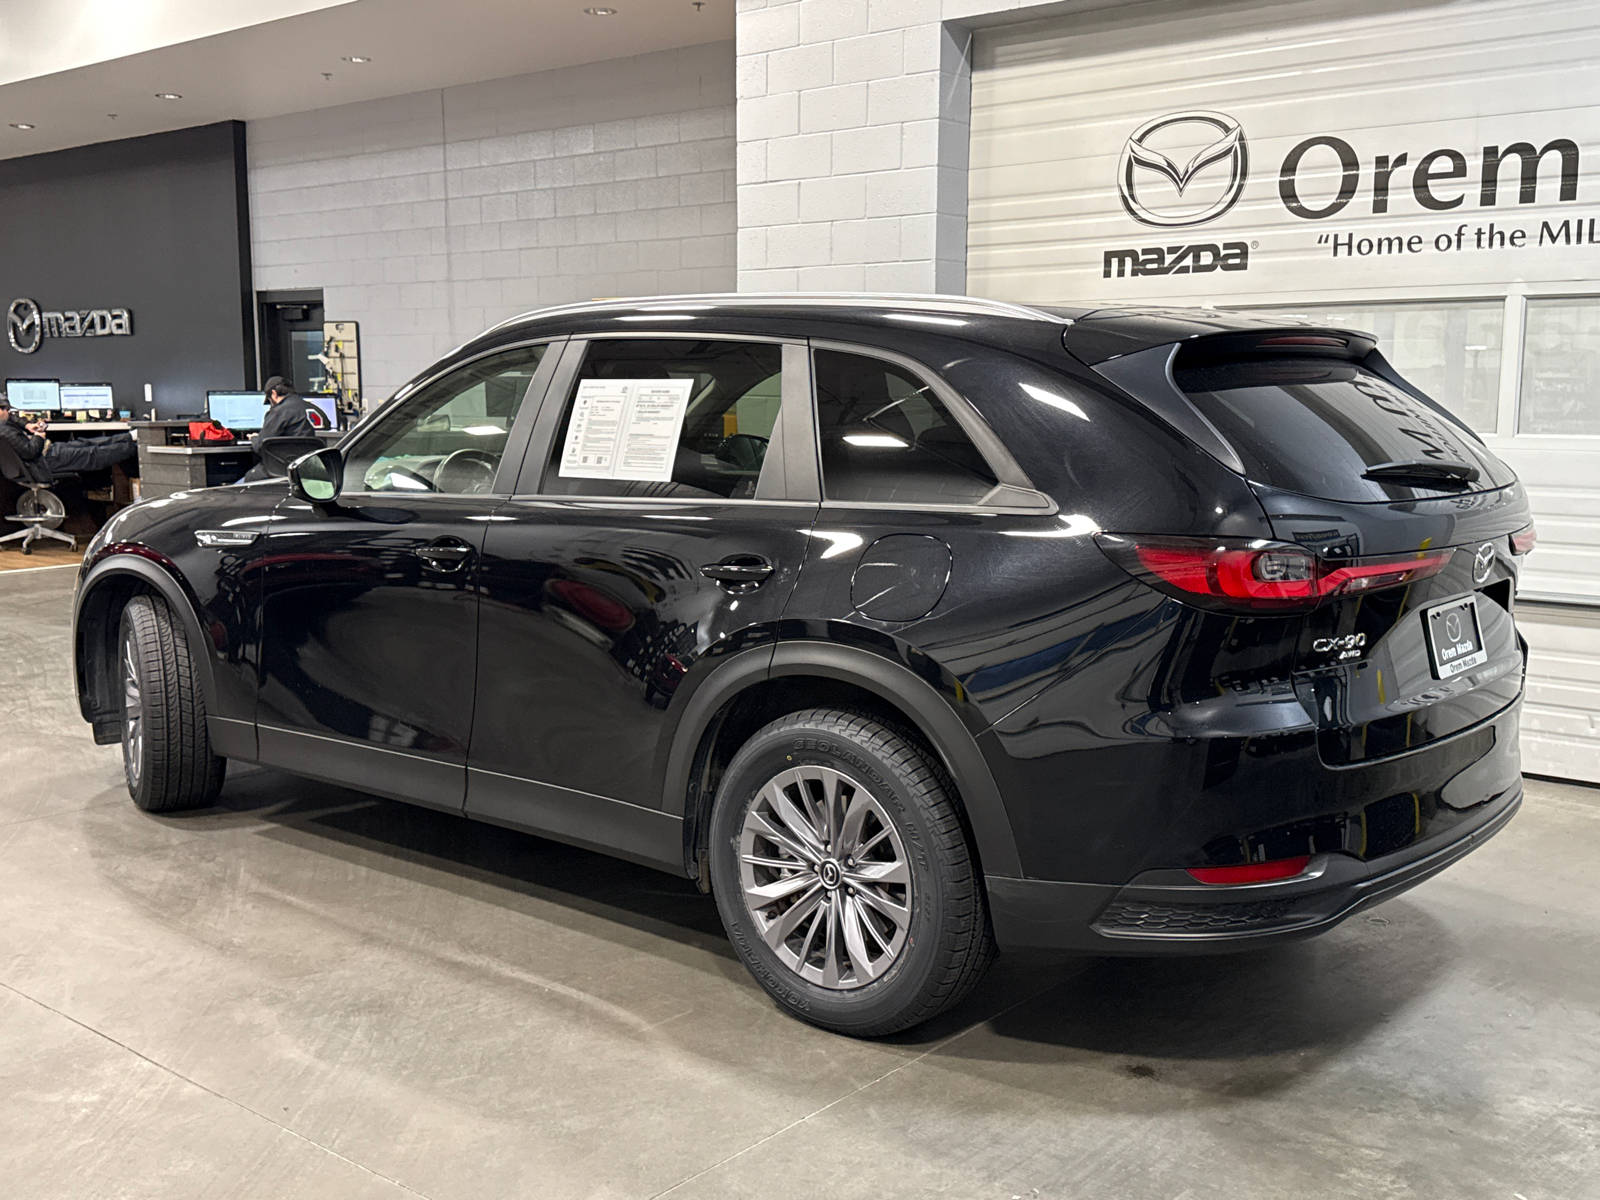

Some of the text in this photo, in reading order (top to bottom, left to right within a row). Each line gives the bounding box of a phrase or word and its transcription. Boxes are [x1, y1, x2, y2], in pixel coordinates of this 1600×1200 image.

[1278, 135, 1580, 220] Orem
[1433, 224, 1469, 252] of
[1475, 222, 1527, 250] the
[1313, 632, 1367, 652] CX-90
[1442, 640, 1473, 660] Orem Mazda
[1339, 649, 1361, 660] AWD
[1450, 656, 1477, 673] Orem Mazda
